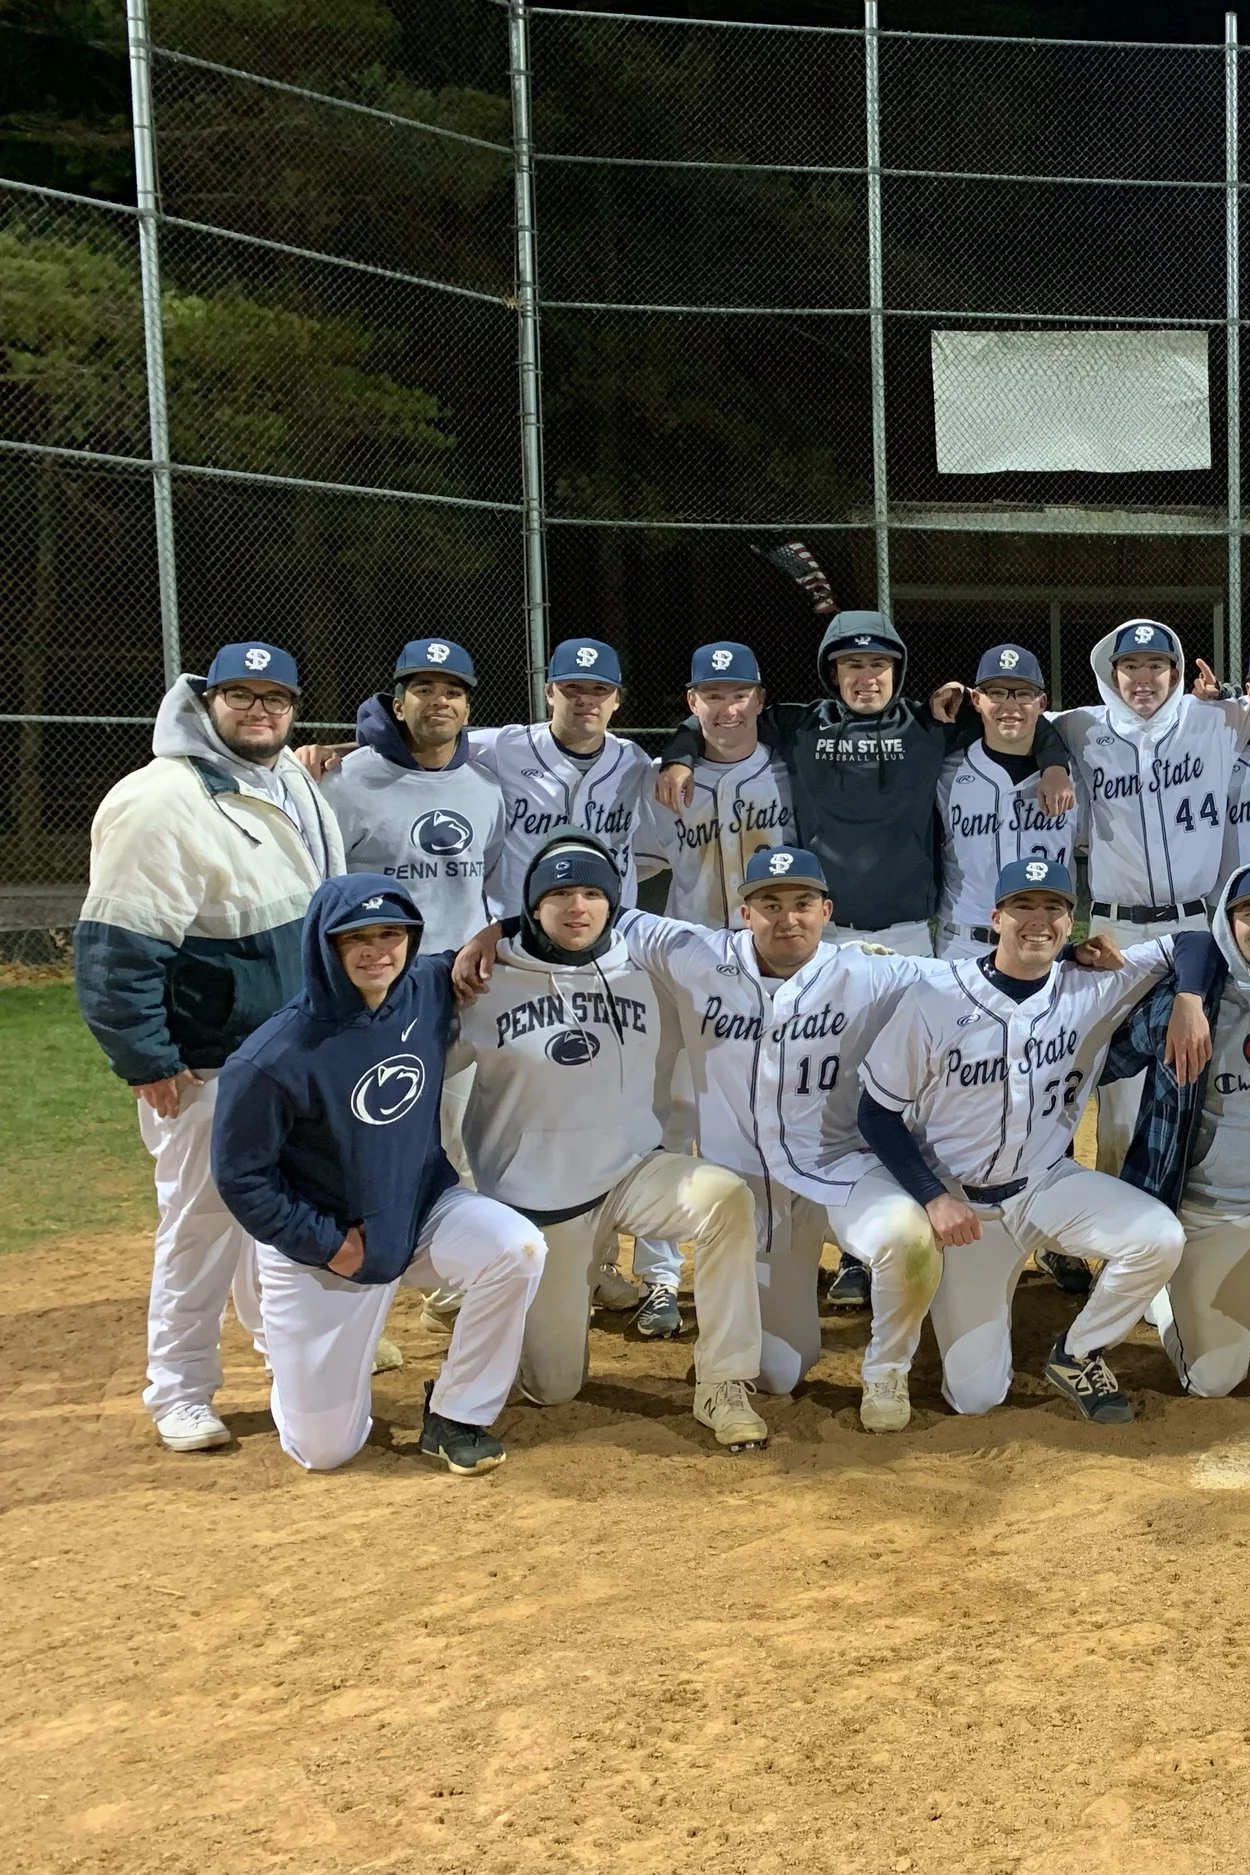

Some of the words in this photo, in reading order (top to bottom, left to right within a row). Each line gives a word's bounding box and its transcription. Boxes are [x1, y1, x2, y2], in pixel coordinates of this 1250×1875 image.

[815, 753, 868, 761] BASEBALL
[876, 753, 904, 761] CLUB
[858, 739, 903, 753] STATE
[1092, 767, 1142, 801] Penn
[1149, 752, 1204, 792] State
[510, 798, 570, 834] Penn
[675, 818, 722, 852] Penn
[729, 800, 792, 833] State
[952, 804, 1002, 837] Penn
[1009, 799, 1068, 831] State
[1175, 792, 1220, 832] 44
[383, 862, 437, 879] PENN
[445, 861, 485, 877] STAT
[496, 995, 565, 1049] PENN
[701, 996, 764, 1041] Penn
[772, 1002, 848, 1043] State
[796, 1054, 840, 1095] 10
[946, 1048, 1010, 1087] Penn
[1018, 1025, 1079, 1074] State
